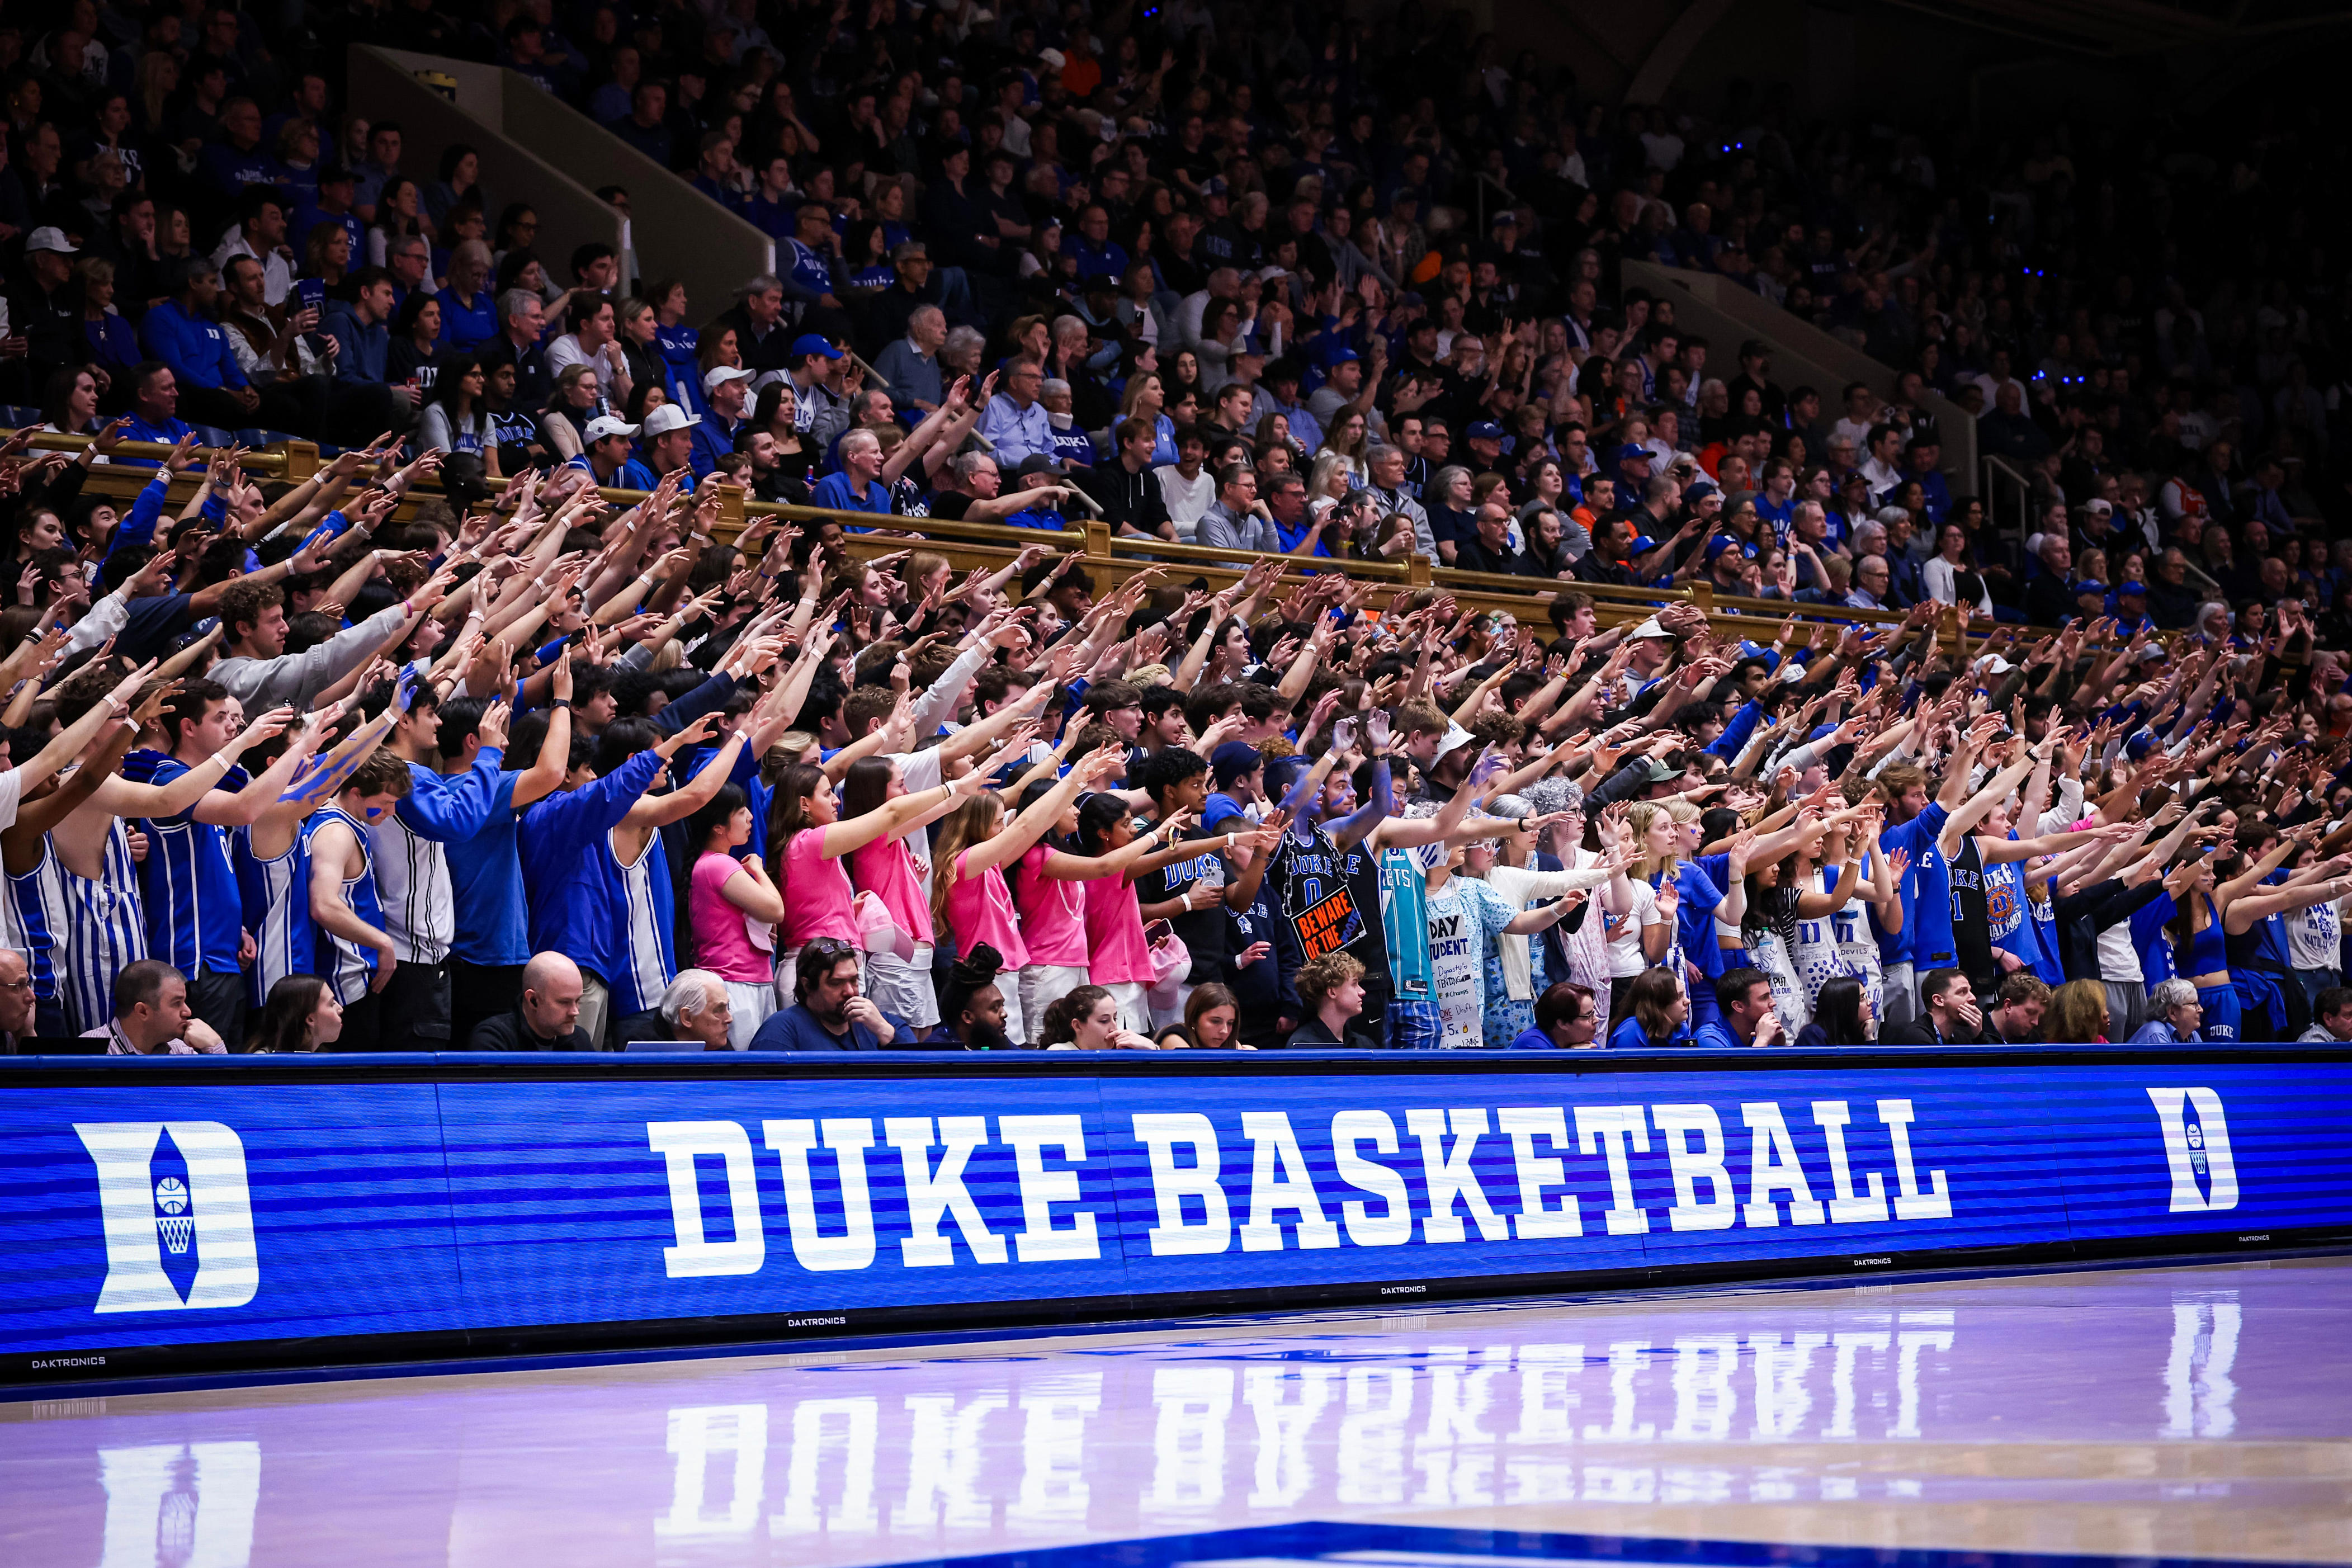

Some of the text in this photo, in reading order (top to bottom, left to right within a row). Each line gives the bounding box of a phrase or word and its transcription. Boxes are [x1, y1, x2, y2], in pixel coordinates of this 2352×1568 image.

[1298, 891, 1352, 939] BEWARE
[1429, 915, 1459, 939] DAY
[1305, 940, 1320, 960] OF
[1319, 924, 1342, 952] THE
[2211, 1024, 2233, 1038] DUKE
[646, 1099, 1953, 1278] DUKE BASKETBALL
[1854, 1257, 1891, 1267] DAKTRONICS
[1381, 1285, 1427, 1296] DAKTRONICS
[788, 1316, 846, 1328] DAKTRONICS
[32, 1356, 106, 1369] DAKTRONICS
